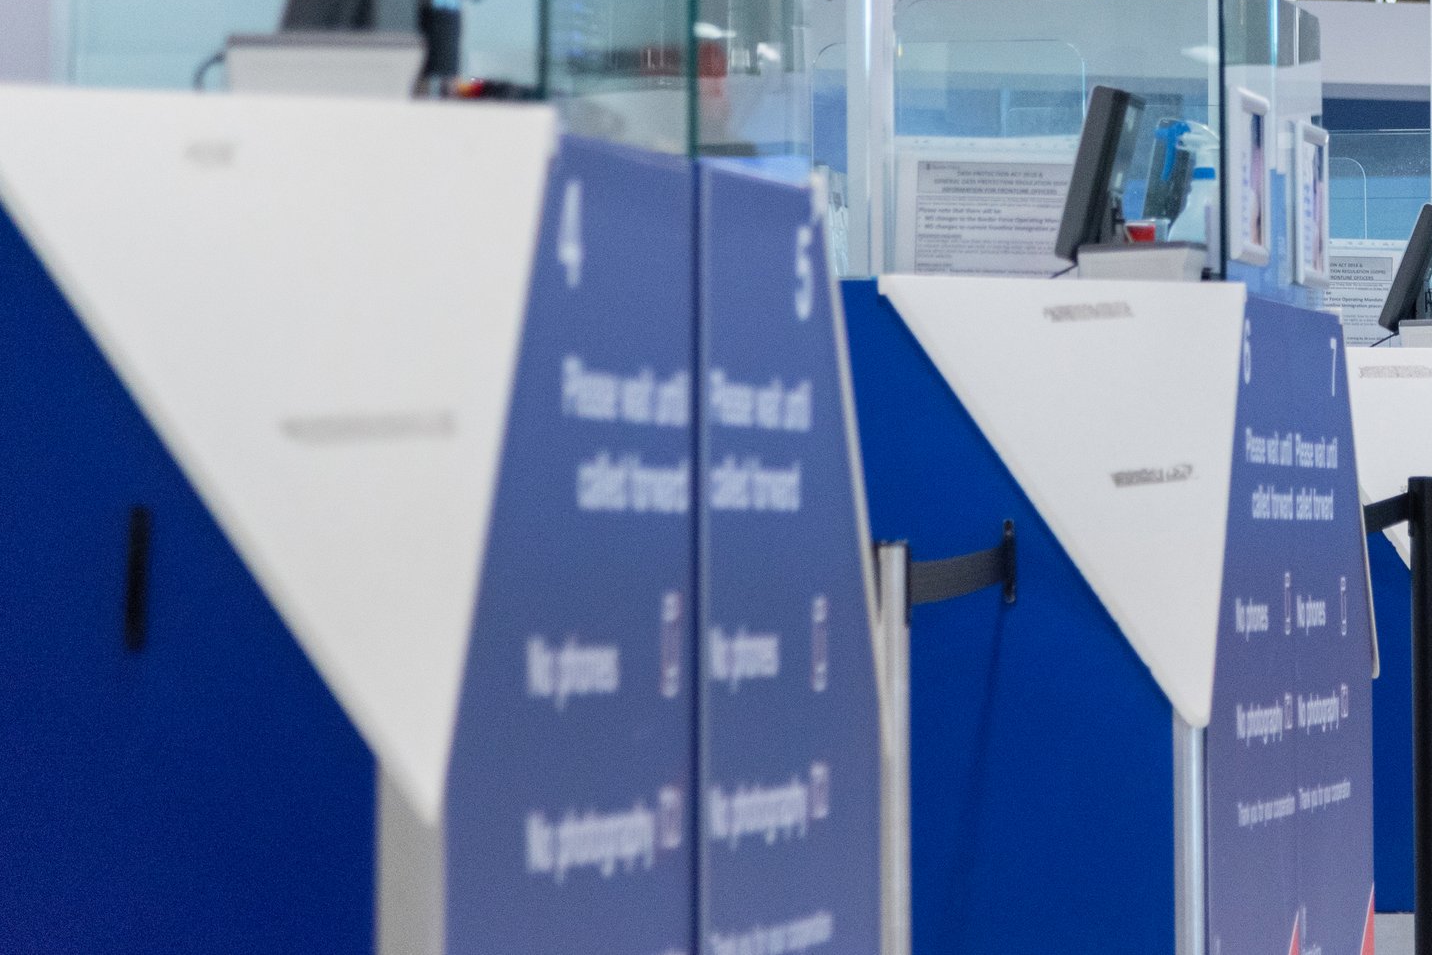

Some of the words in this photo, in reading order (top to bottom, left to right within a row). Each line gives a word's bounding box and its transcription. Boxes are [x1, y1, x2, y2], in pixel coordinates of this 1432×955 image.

[1244, 319, 1251, 384] 6
[1330, 338, 1337, 396] 7
[1246, 428, 1266, 464] Please
[1295, 434, 1314, 468] Please
[1236, 599, 1246, 632] No
[1246, 599, 1268, 642] phones
[1297, 595, 1305, 628] No
[1305, 596, 1326, 636] phones
[1237, 705, 1246, 739] No
[1246, 700, 1283, 746] photography
[1298, 695, 1306, 727] No
[1307, 691, 1340, 735] photography
